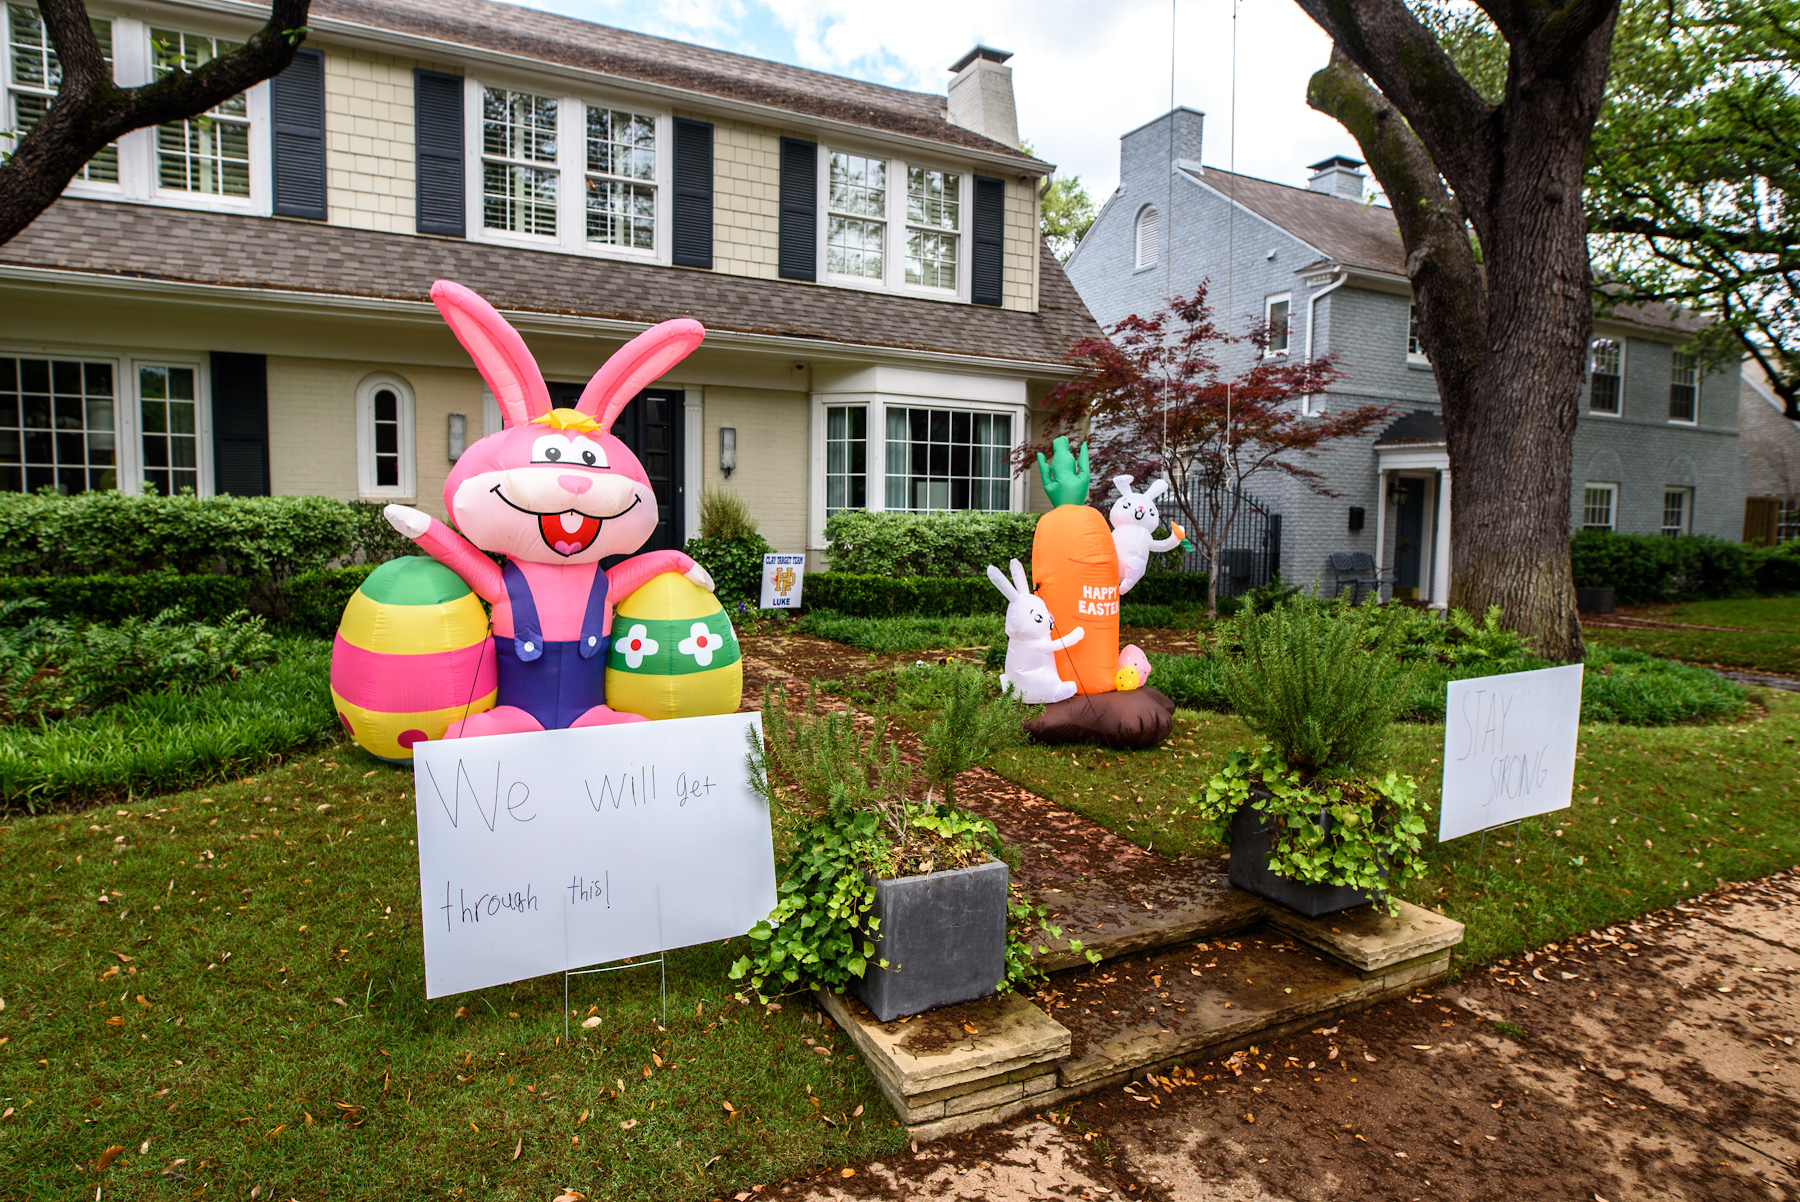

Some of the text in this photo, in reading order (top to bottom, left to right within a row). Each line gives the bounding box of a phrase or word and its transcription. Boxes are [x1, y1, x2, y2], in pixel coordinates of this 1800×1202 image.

[773, 598, 790, 606] LUKE
[1083, 585, 1117, 600] HAPPY
[1457, 690, 1513, 761] STAY
[425, 758, 537, 832] We
[676, 771, 717, 807] get
[1483, 745, 1548, 807] STRONG
[440, 869, 611, 932] through this!
